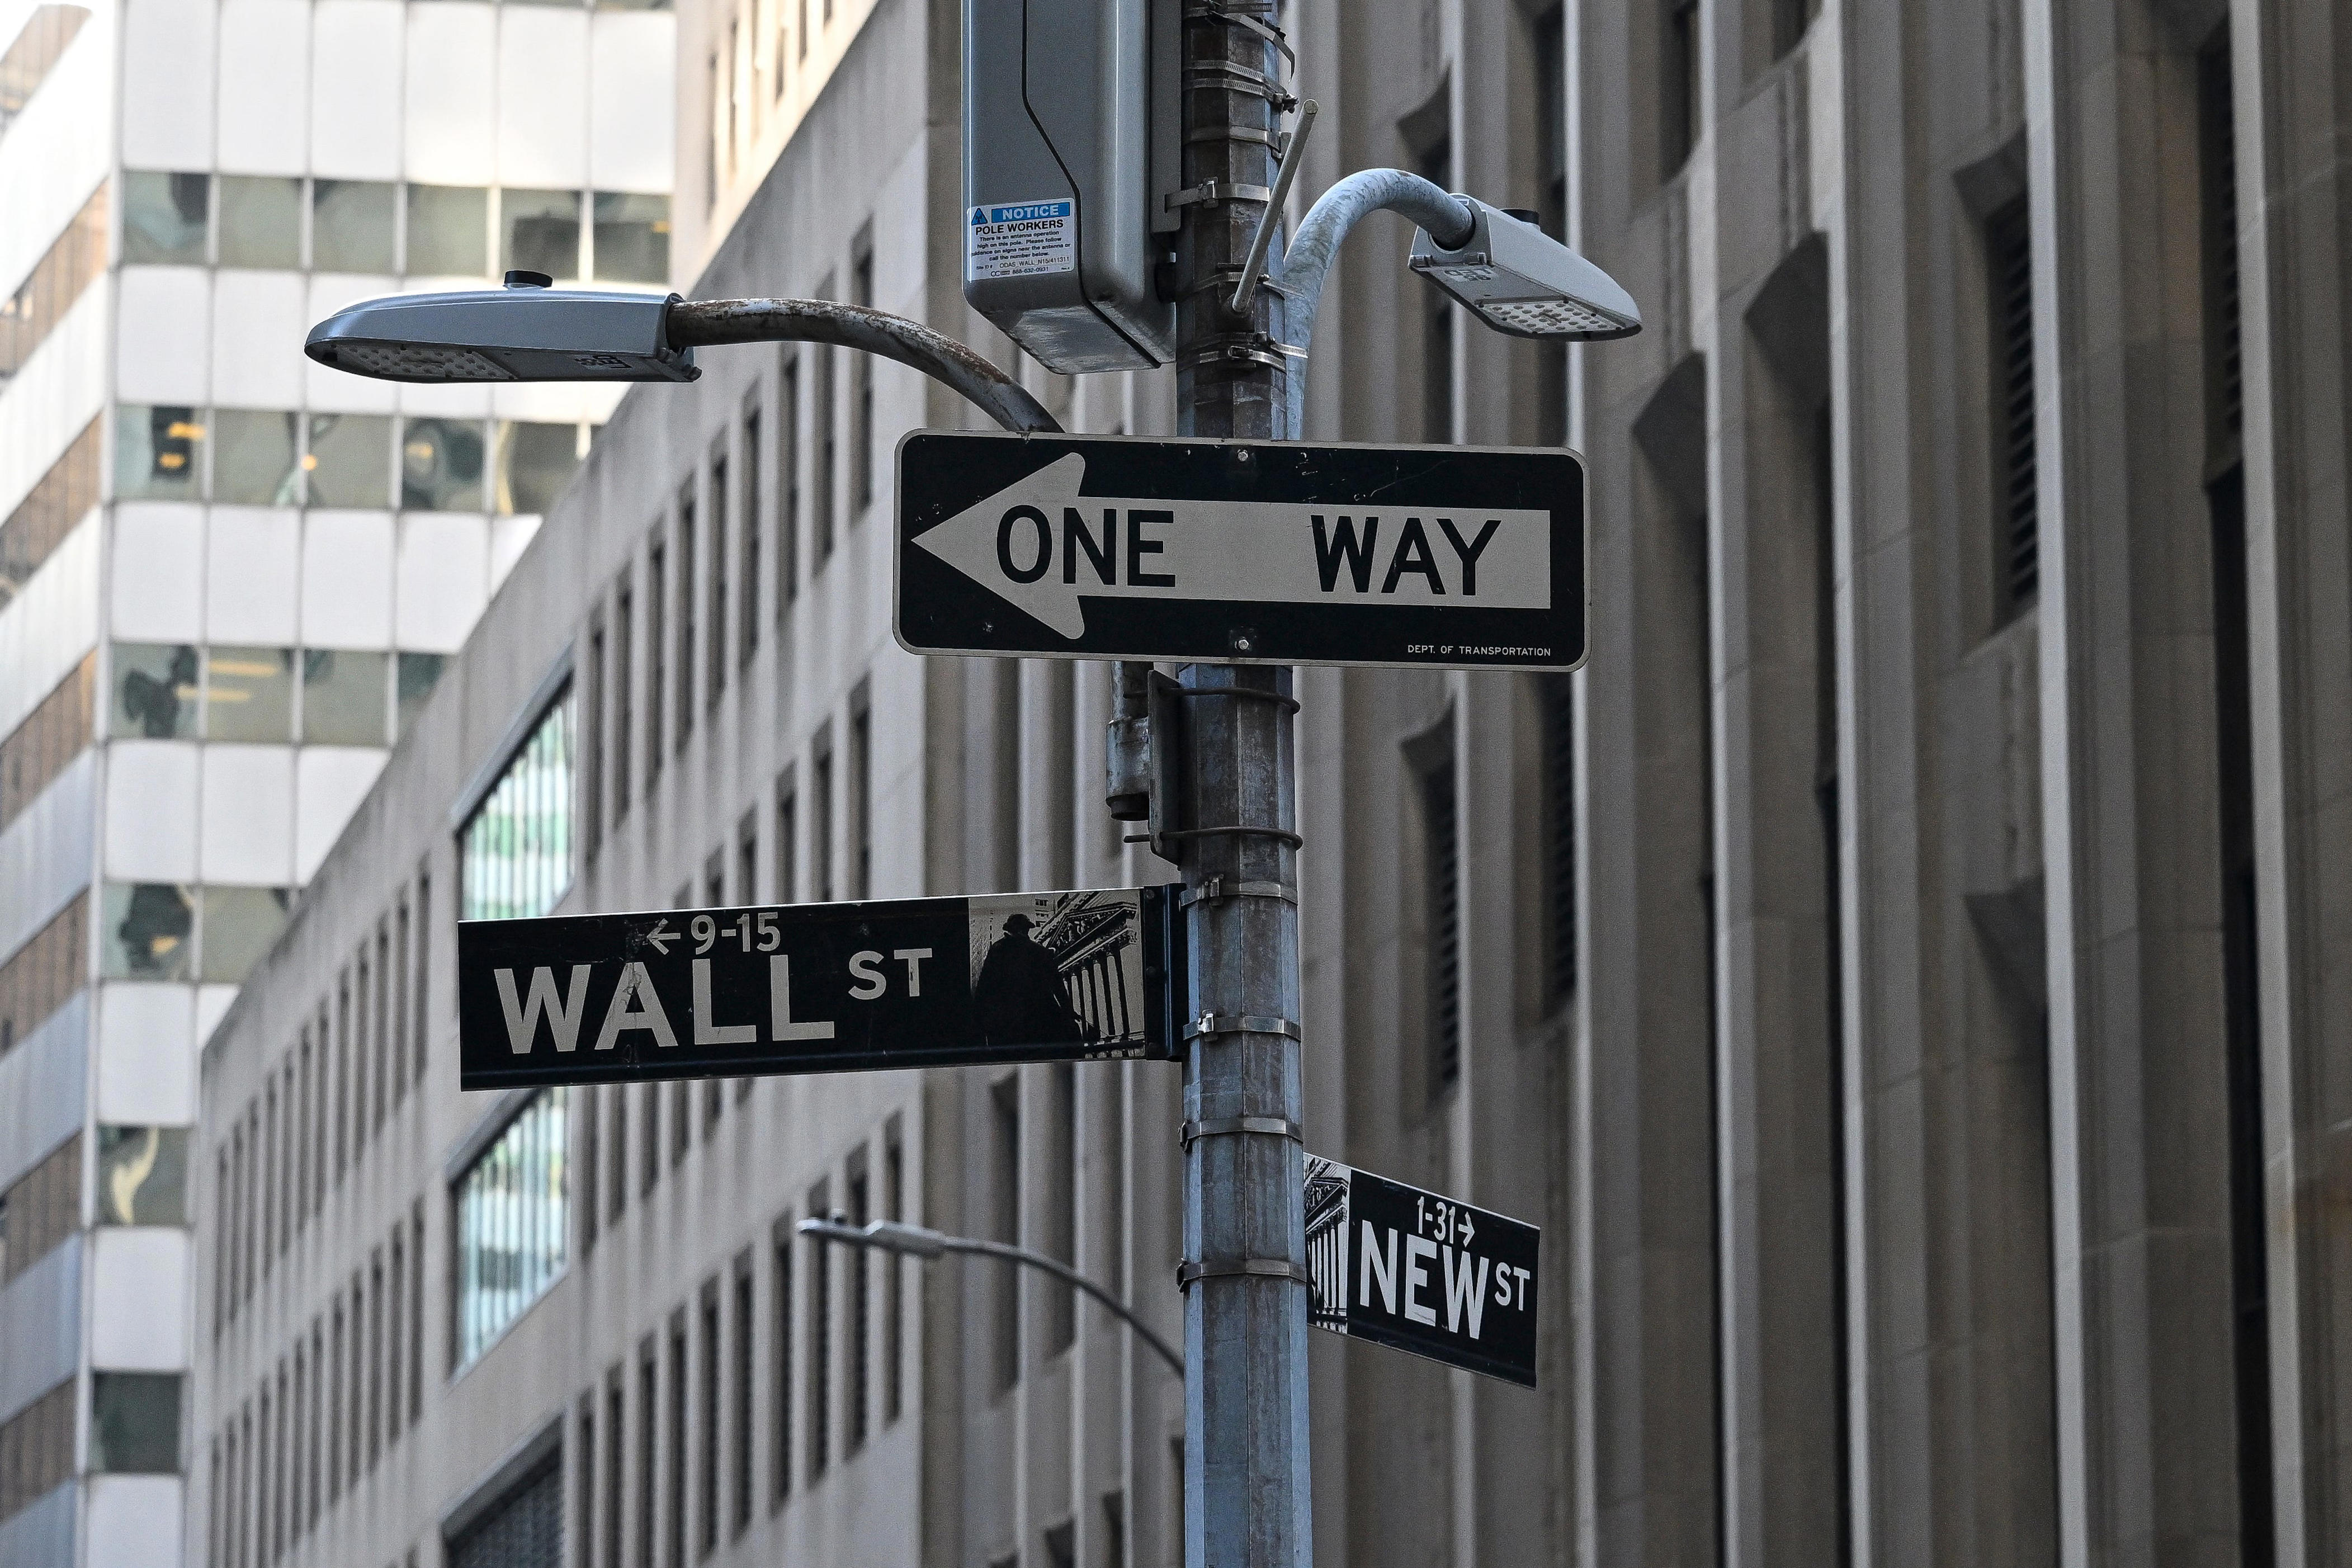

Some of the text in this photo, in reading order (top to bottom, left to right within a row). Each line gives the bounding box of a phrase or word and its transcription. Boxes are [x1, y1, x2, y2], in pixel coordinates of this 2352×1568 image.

[976, 219, 1064, 235] POLE WORKERS
[1003, 205, 1059, 220] NOTICE
[996, 504, 1503, 597] ONE WAY
[1408, 645, 1551, 657] DEPT. OF TRANSPORTATION
[689, 912, 781, 955] 9-15
[494, 948, 933, 1055] WALL ST
[1417, 1196, 1456, 1244] 1-31
[1359, 1219, 1531, 1340] NEW ST
